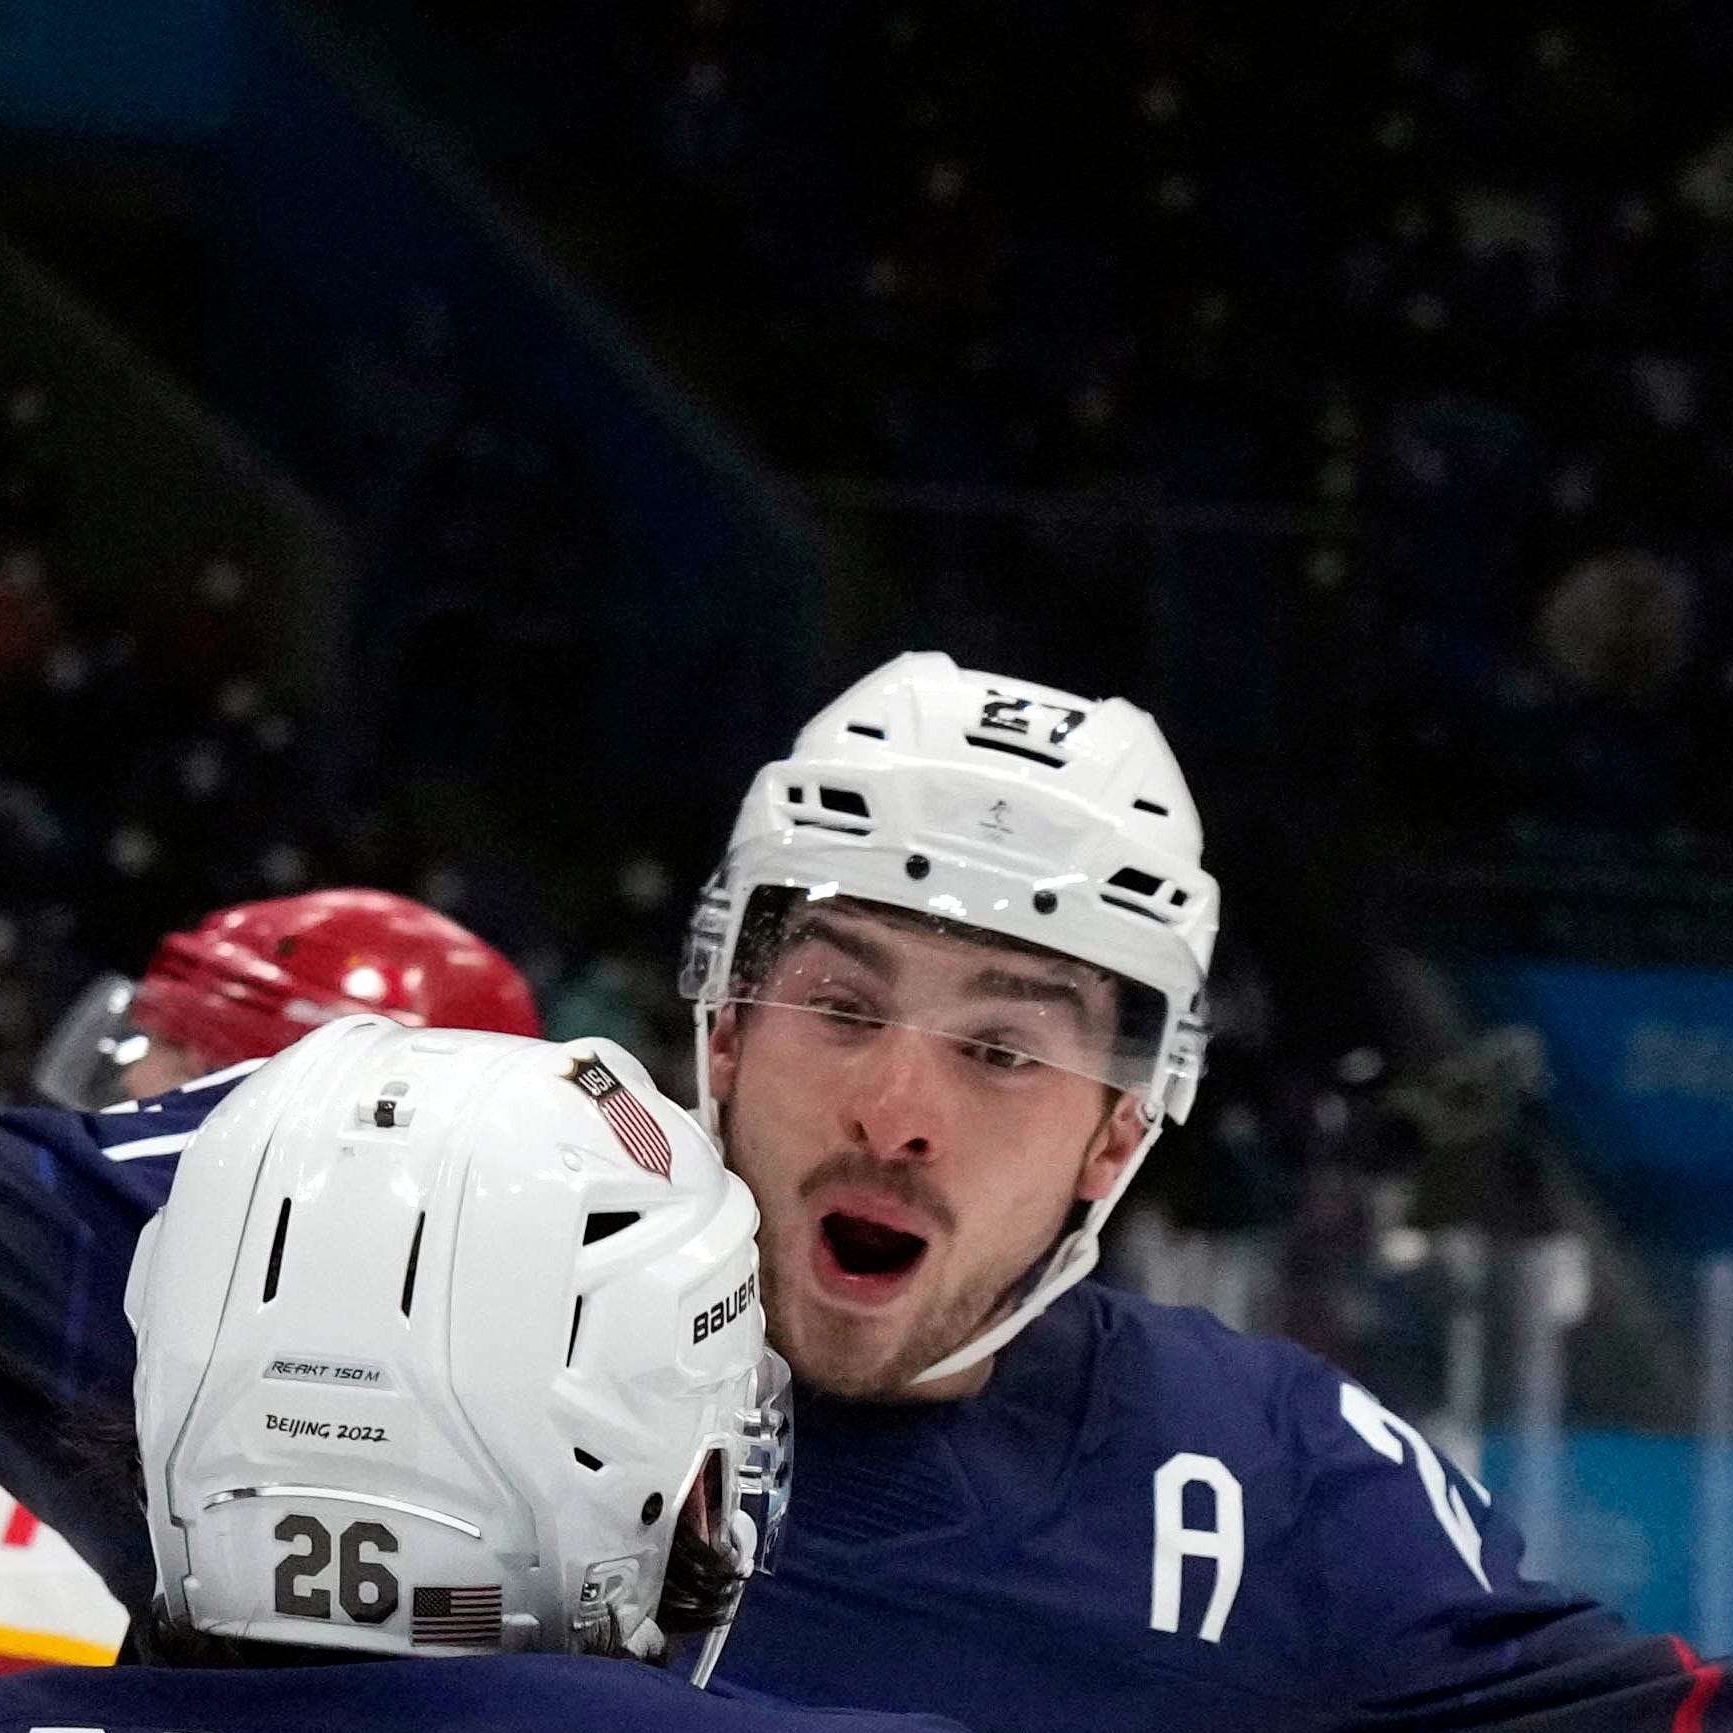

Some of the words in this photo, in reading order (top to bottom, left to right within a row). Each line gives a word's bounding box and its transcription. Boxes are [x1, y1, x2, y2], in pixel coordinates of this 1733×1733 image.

[578, 1065, 617, 1097] USA
[692, 1272, 756, 1345] BAUER
[265, 1413, 332, 1439] BEIJING
[337, 1424, 391, 1443] 2022
[274, 1514, 400, 1625] 26
[1149, 1452, 1245, 1644] A
